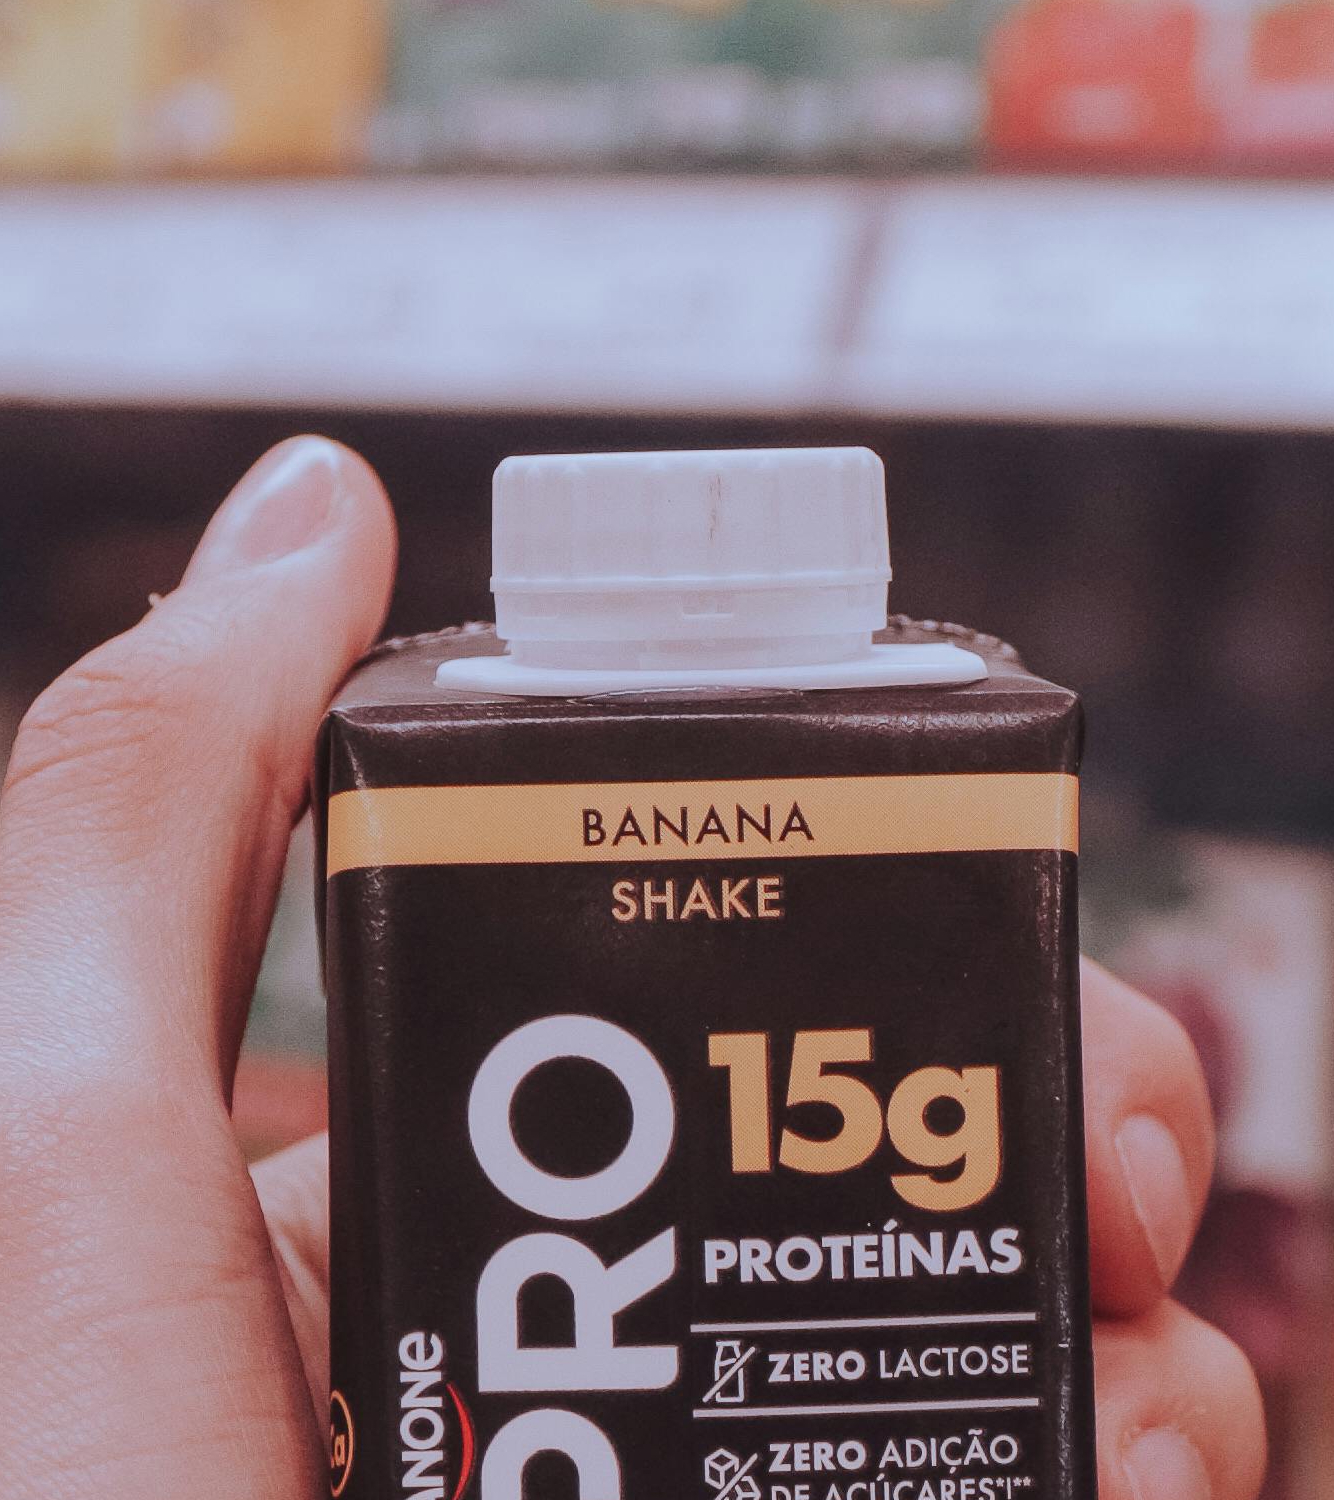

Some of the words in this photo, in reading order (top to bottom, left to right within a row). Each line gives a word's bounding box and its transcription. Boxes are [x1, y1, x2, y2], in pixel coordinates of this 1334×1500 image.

[581, 802, 815, 847] BANANA
[611, 876, 785, 922] SHAKE
[708, 1027, 1003, 1212] 15g
[704, 1220, 1023, 1285] PROTEÍNAS
[768, 1350, 866, 1383] ZERO
[879, 1344, 1030, 1379] LACTOSE
[769, 1440, 867, 1473] ZERO
[878, 1429, 1019, 1474] ADIÇÃO
